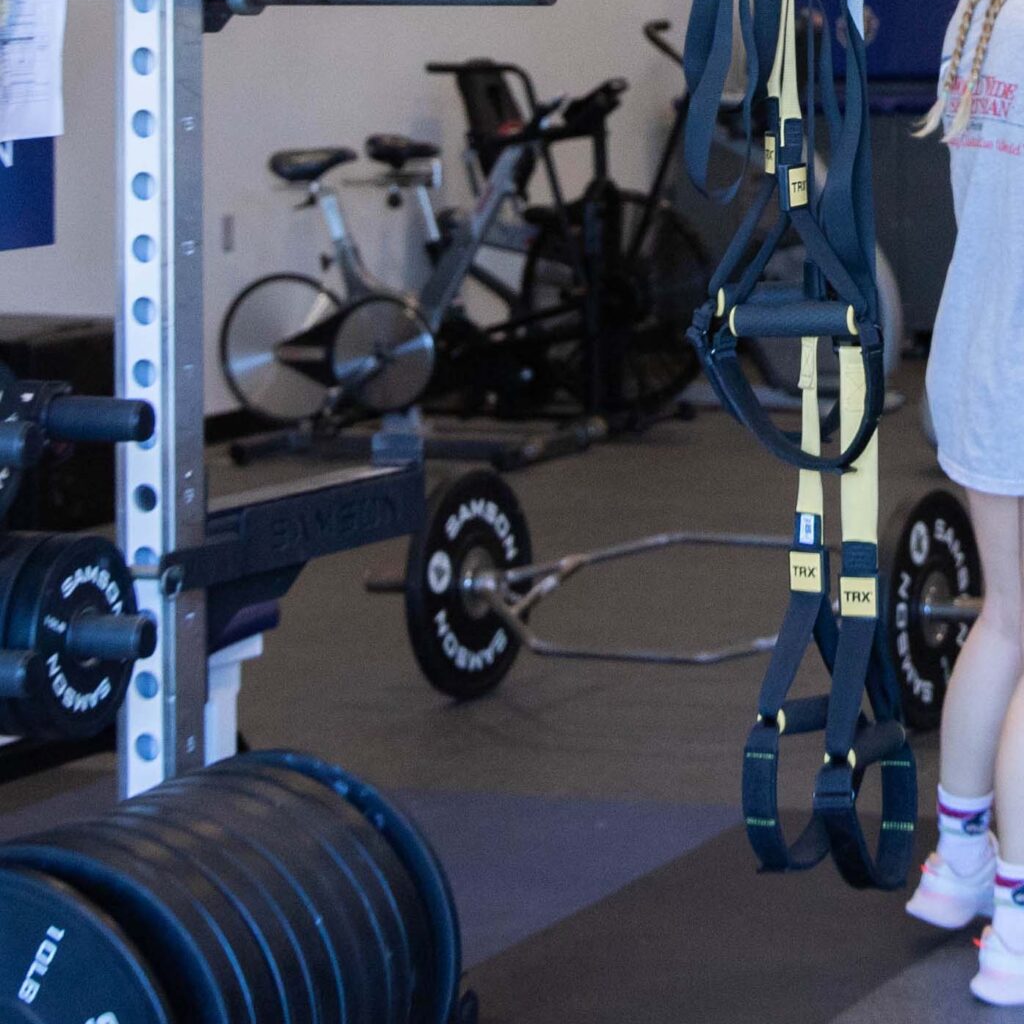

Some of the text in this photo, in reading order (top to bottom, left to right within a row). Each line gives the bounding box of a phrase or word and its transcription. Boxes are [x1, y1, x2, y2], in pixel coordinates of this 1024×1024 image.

[445, 498, 518, 561] SAMSON
[793, 565, 816, 578] TRX
[844, 590, 872, 603] TRX
[434, 608, 509, 672] SAMSON
[46, 652, 112, 713] SAMSON
[18, 925, 66, 1005] 10LB
